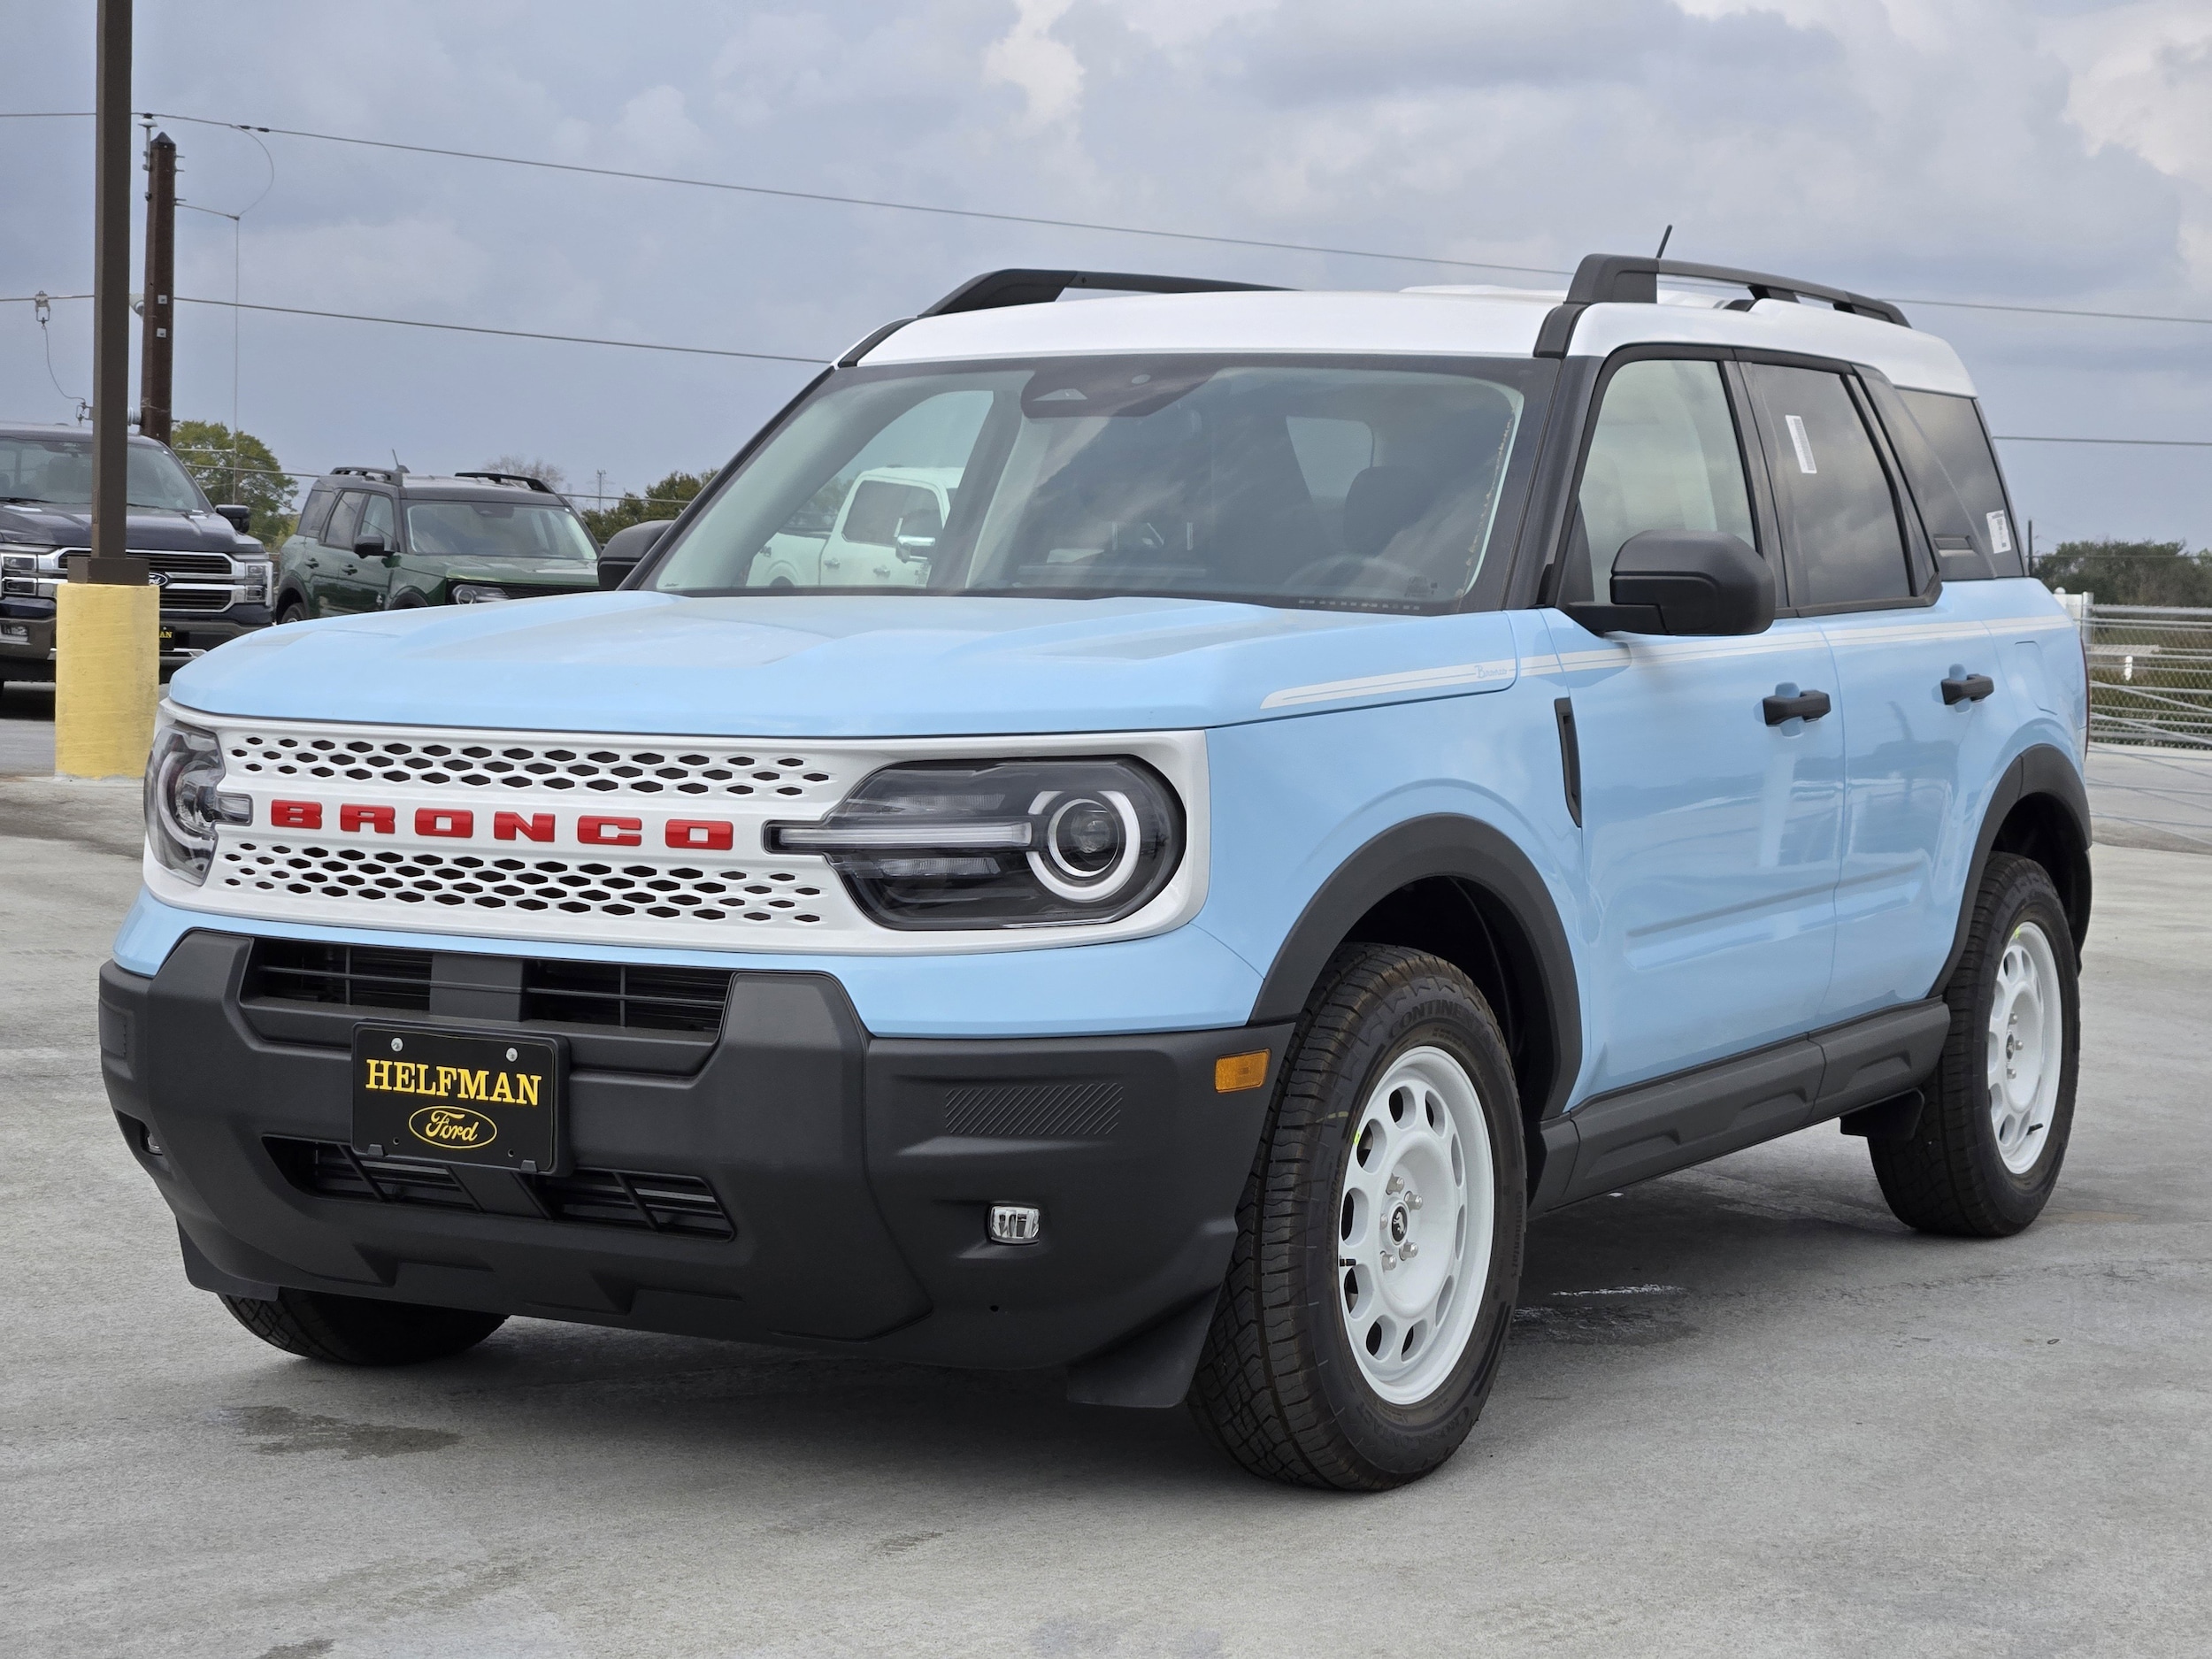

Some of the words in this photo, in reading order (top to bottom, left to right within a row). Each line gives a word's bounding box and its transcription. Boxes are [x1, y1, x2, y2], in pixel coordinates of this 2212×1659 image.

[271, 799, 733, 850] BRONCO
[365, 1058, 542, 1106] HELFMAN
[425, 1110, 479, 1141] Ford
